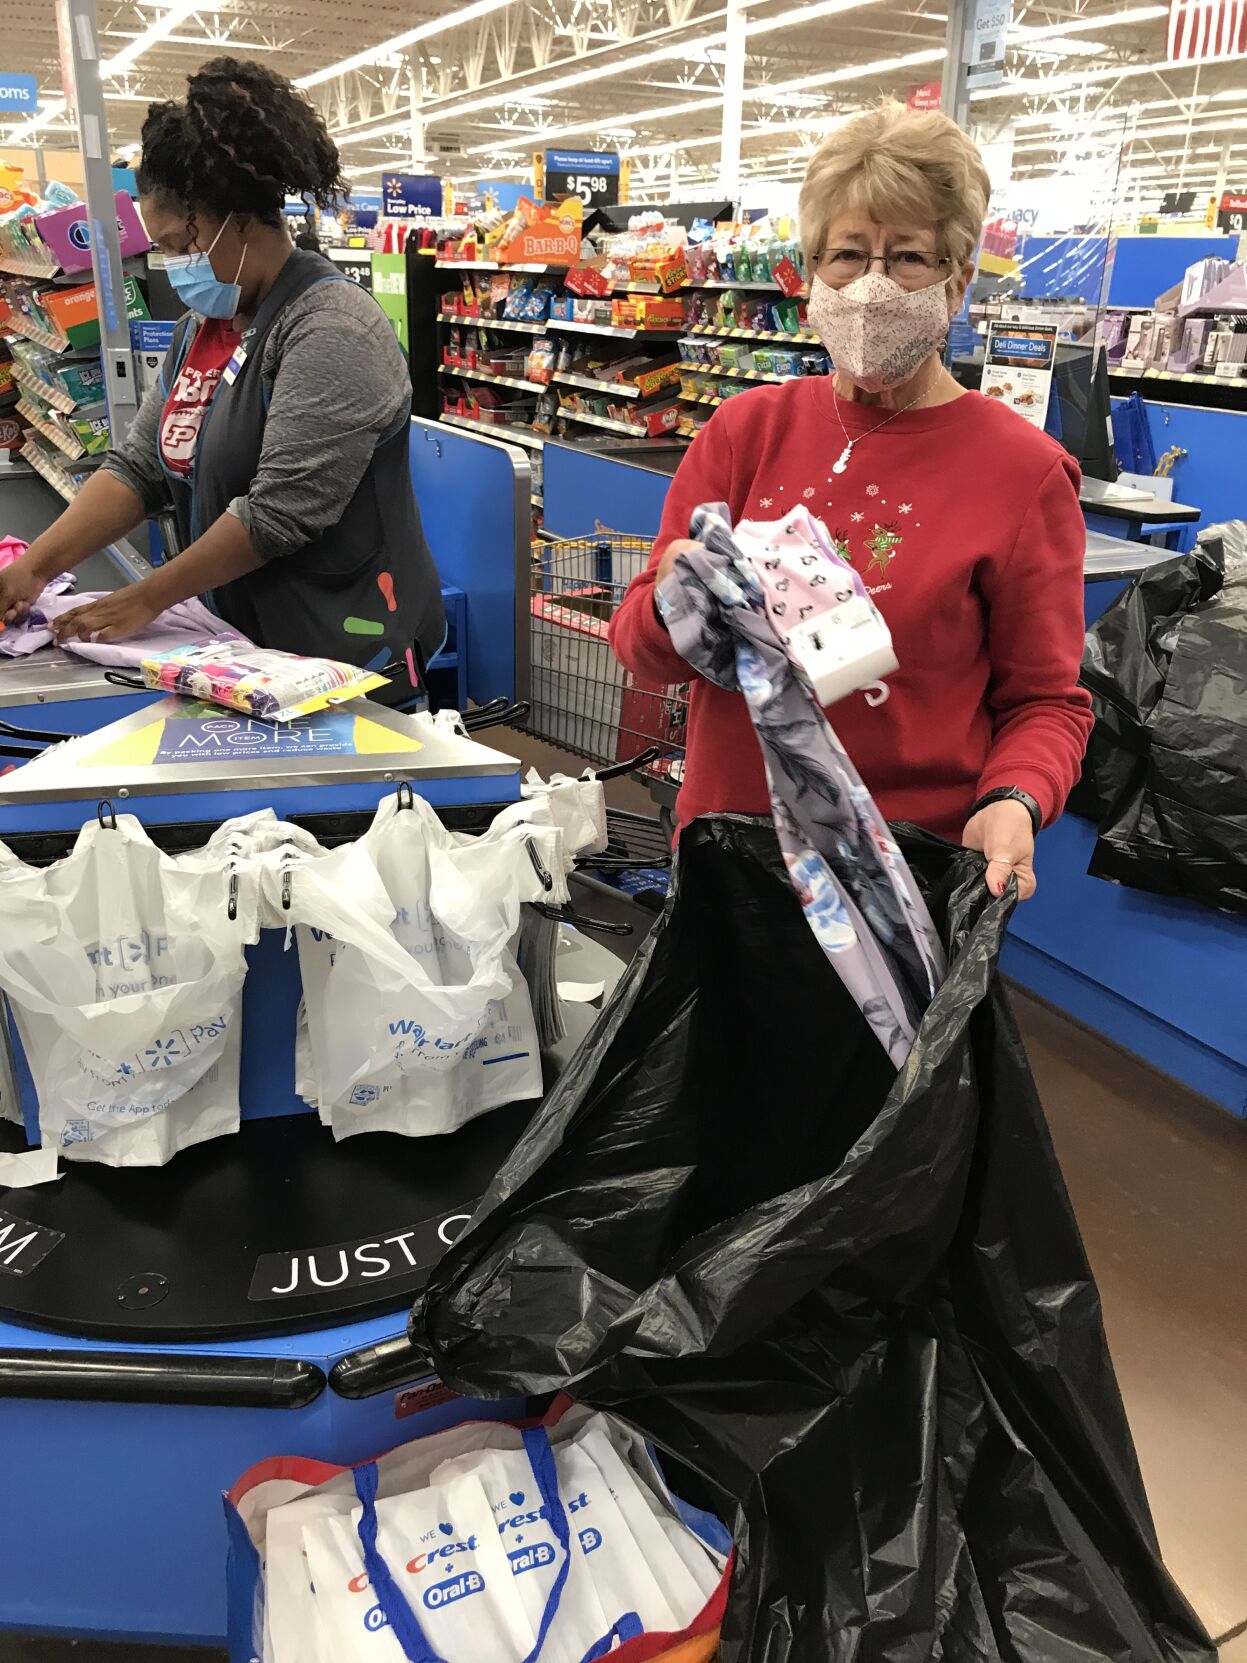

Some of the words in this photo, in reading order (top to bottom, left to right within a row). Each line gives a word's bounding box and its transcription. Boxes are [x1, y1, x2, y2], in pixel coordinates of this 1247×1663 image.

[976, 18, 990, 30] Get
[991, 14, 1006, 29] $50
[387, 203, 407, 213] Low
[408, 204, 432, 215] Price
[64, 289, 96, 306] orange
[994, 340, 1007, 349] Deli
[1007, 341, 1029, 351] Dinner
[1028, 342, 1046, 353] Deals
[178, 728, 334, 749] MORE
[86, 1100, 106, 1113] Get
[108, 1103, 126, 1114] the
[128, 1103, 150, 1117] App
[271, 1231, 416, 1295] JUST
[419, 1529, 437, 1544] WE
[405, 1534, 480, 1574] Crest
[512, 1546, 551, 1573] ral-B
[427, 1572, 482, 1607] Oral-B
